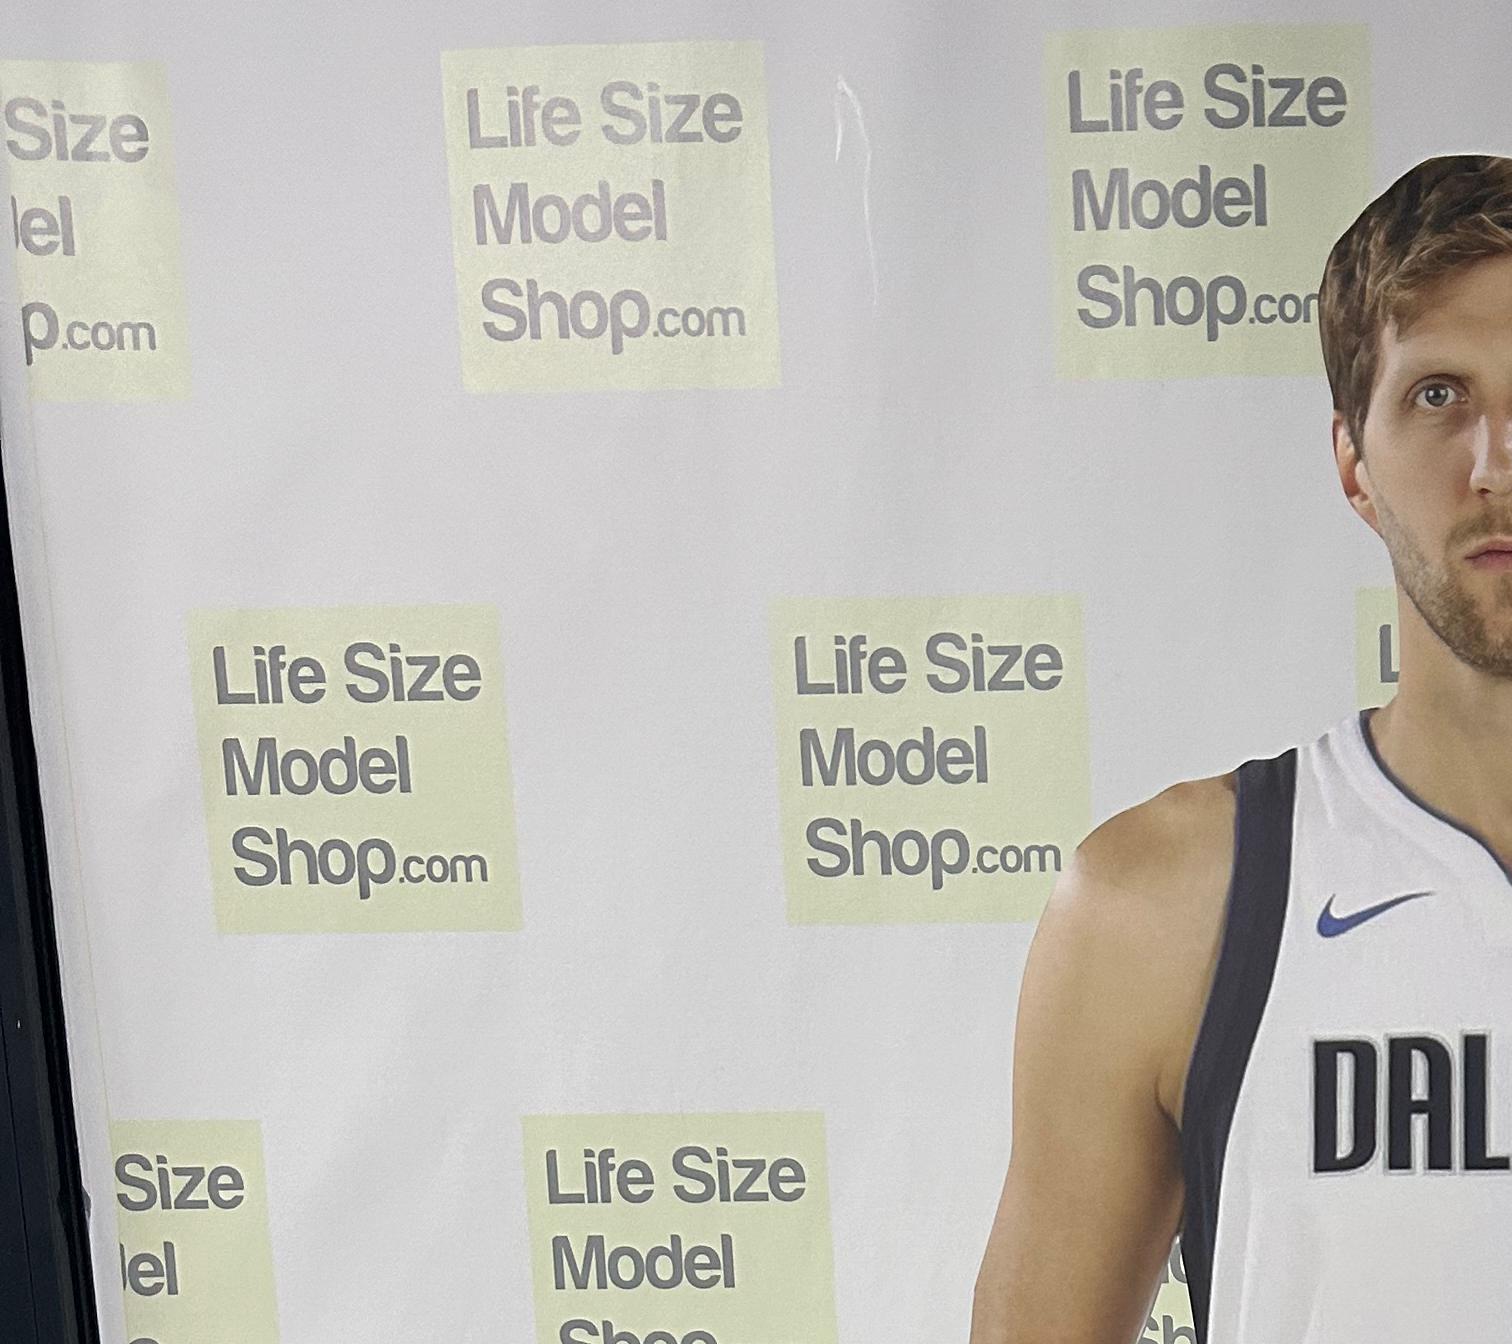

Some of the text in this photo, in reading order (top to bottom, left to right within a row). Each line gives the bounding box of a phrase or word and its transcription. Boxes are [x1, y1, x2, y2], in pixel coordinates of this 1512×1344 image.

[5, 97, 149, 163] Size
[467, 78, 743, 149] Life Size
[1068, 63, 1347, 133] Life Size
[11, 195, 75, 256] el
[473, 179, 667, 246] Model
[1073, 164, 1267, 231] Model
[482, 279, 744, 354] Shop.com
[213, 642, 481, 705] Life Size
[794, 633, 1063, 695] Life Size
[222, 735, 411, 796] Model
[800, 726, 988, 786] Model
[232, 827, 488, 900] Shop.com
[806, 817, 1062, 891] Shop.com
[115, 1154, 245, 1212] Size
[546, 1146, 806, 1204] Life Size
[552, 1234, 735, 1290] Model
